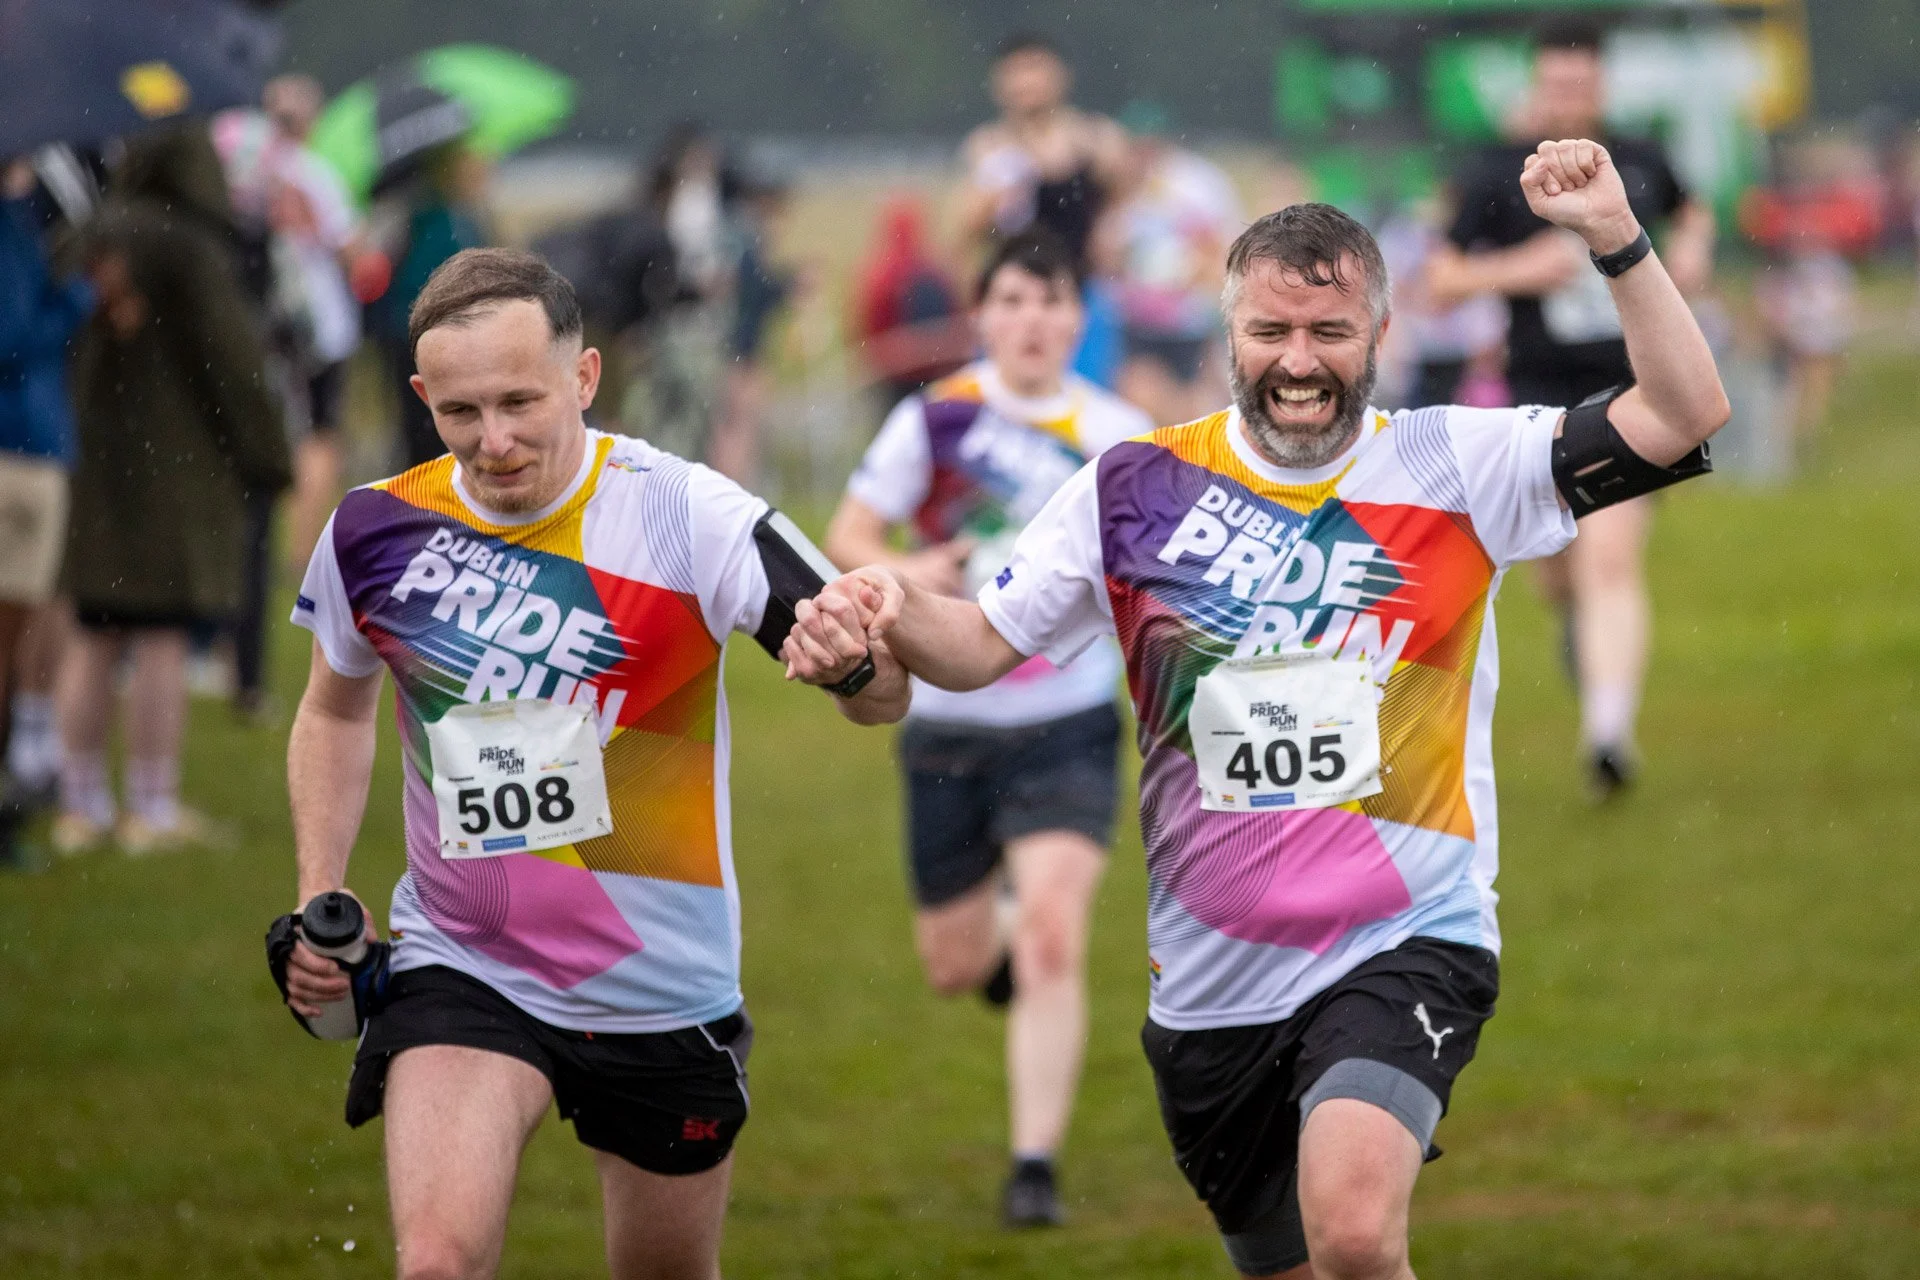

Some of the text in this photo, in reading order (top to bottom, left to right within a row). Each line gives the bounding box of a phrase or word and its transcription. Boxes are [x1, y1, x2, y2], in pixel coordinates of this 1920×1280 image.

[425, 527, 540, 590] DUBLIN
[1157, 506, 1380, 607] PRIDE
[390, 549, 612, 677] PRIDE
[1232, 604, 1416, 686] RUN
[1250, 703, 1288, 718] PRIDE
[1270, 713, 1297, 727] RUN
[479, 747, 515, 763] PRIDE
[498, 757, 525, 772] RUN
[1226, 733, 1346, 790] 405
[457, 776, 575, 836] 508
